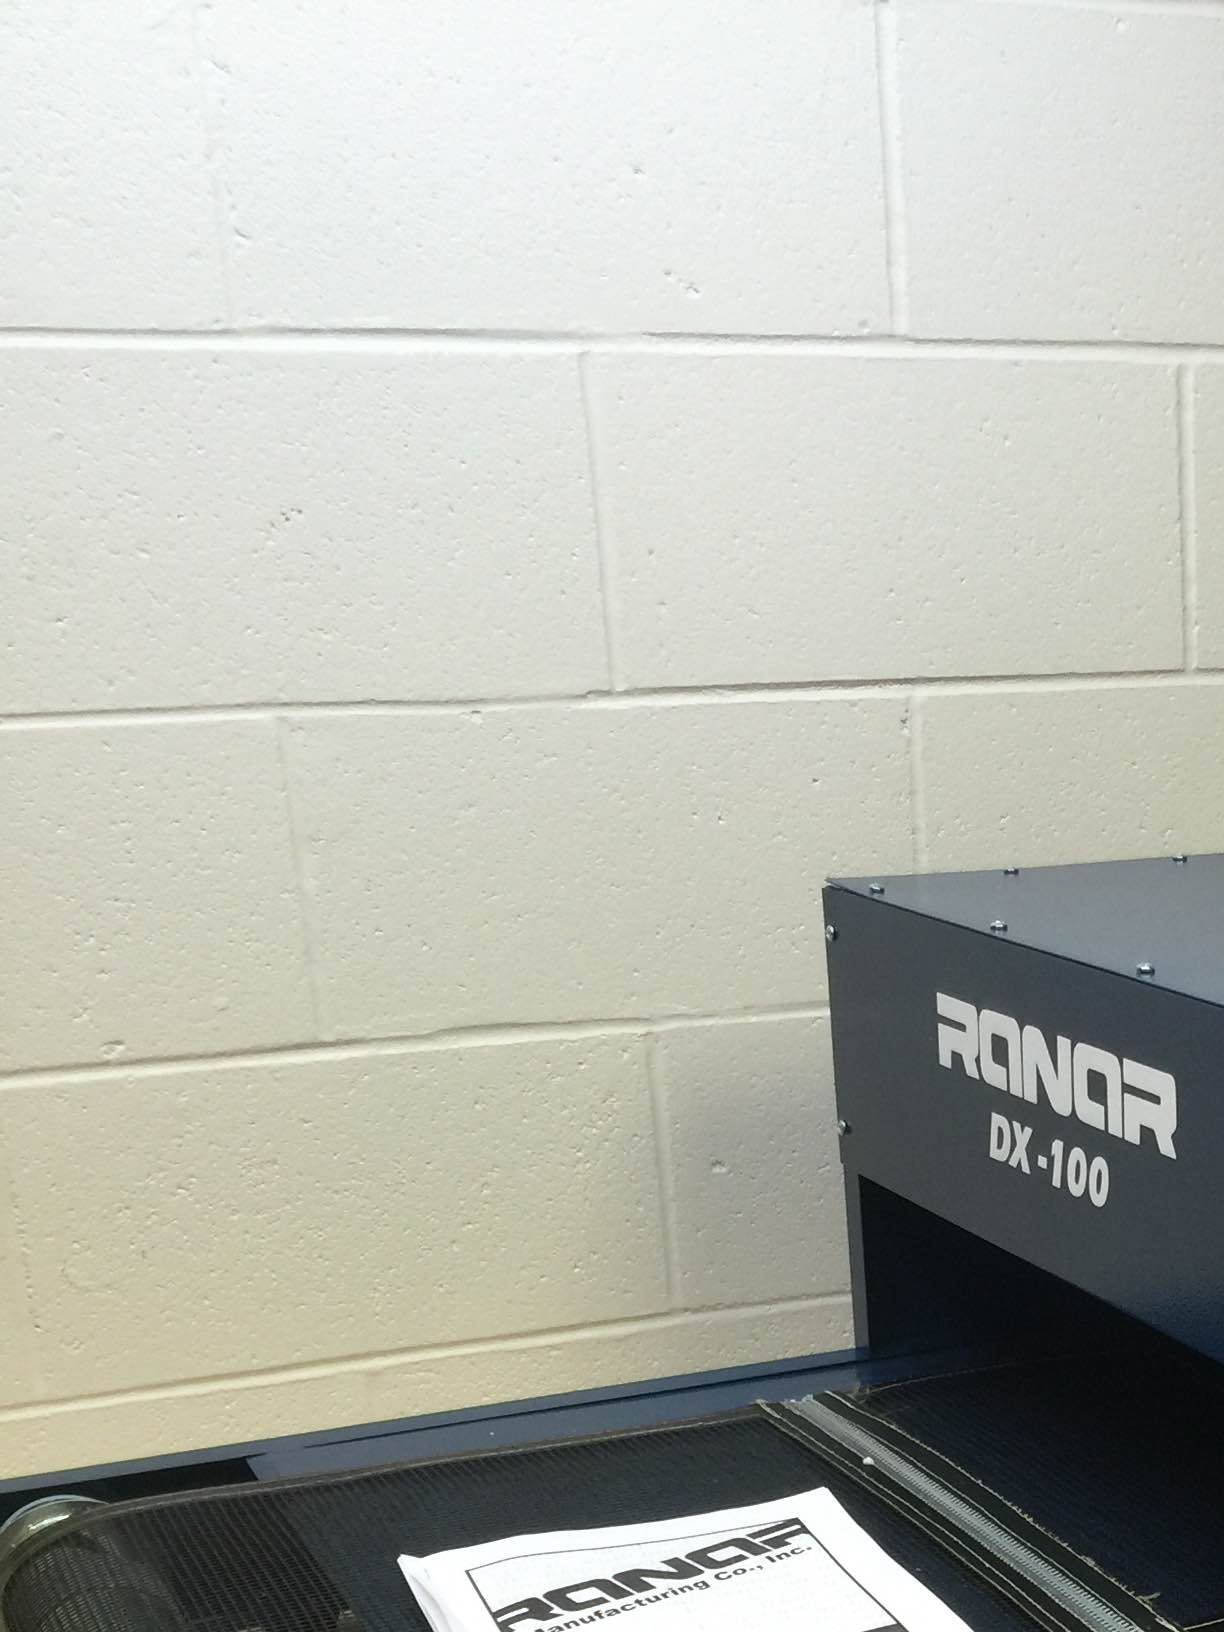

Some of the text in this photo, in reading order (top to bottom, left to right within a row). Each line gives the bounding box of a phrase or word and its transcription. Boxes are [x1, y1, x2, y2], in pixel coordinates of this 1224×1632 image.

[936, 992, 1178, 1160] RANAR
[714, 1564, 764, 1581] Co.,
[765, 1547, 812, 1563] Inc.
